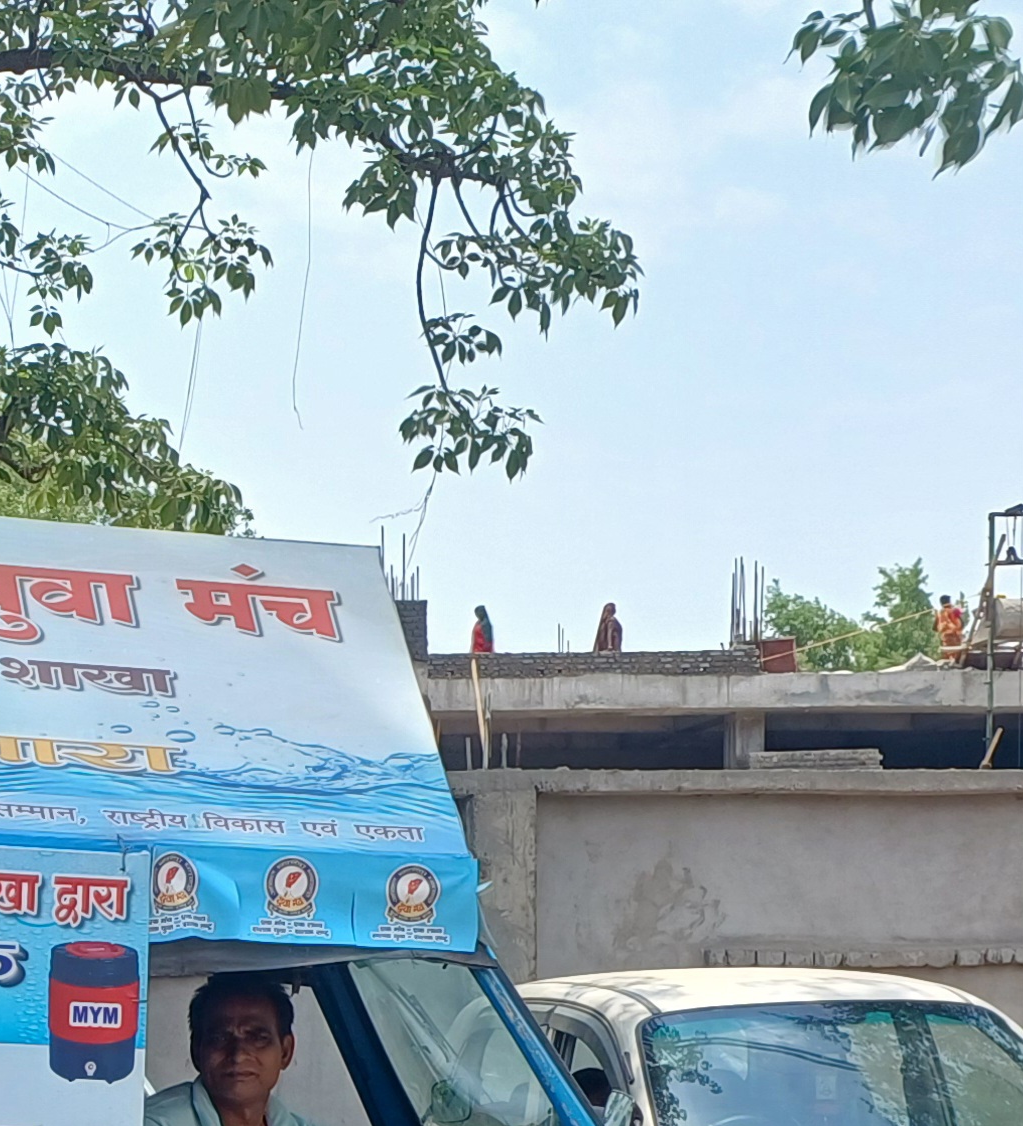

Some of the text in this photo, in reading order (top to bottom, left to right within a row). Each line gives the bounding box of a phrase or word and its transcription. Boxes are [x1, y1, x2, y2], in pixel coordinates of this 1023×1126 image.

[175, 563, 339, 640] मंच
[101, 808, 188, 830] राष्ट्रीय
[202, 811, 285, 834] विकास
[299, 819, 338, 837] एवं
[353, 824, 425, 842] एकता
[53, 876, 129, 924] द्वारा
[71, 1005, 119, 1025] MYM
